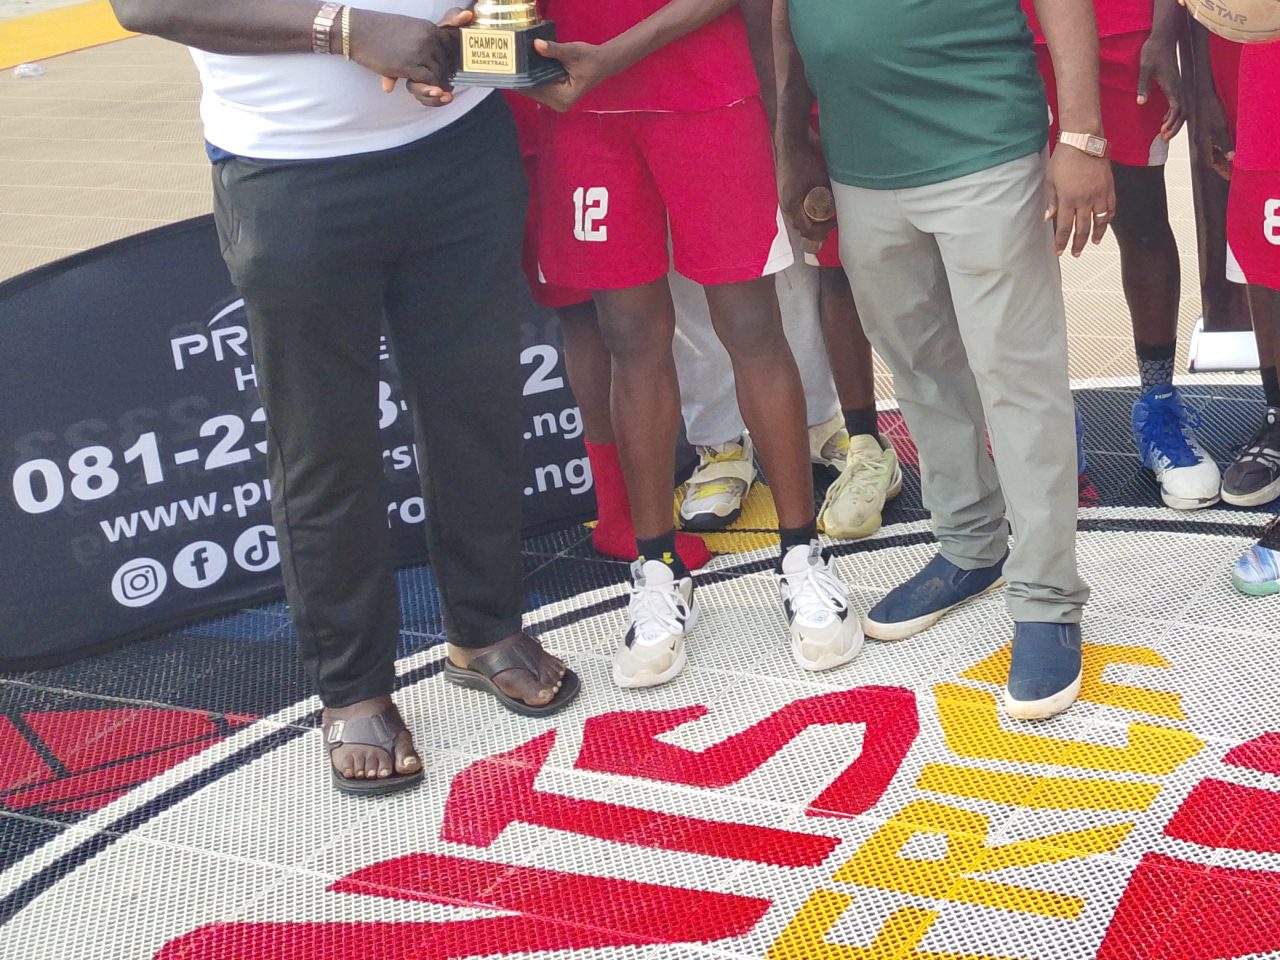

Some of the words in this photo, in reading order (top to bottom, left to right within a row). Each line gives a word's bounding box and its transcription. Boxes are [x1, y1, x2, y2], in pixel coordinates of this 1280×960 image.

[469, 36, 509, 50] CHAMPION
[492, 51, 508, 59] KIDA
[572, 186, 609, 242] 12
